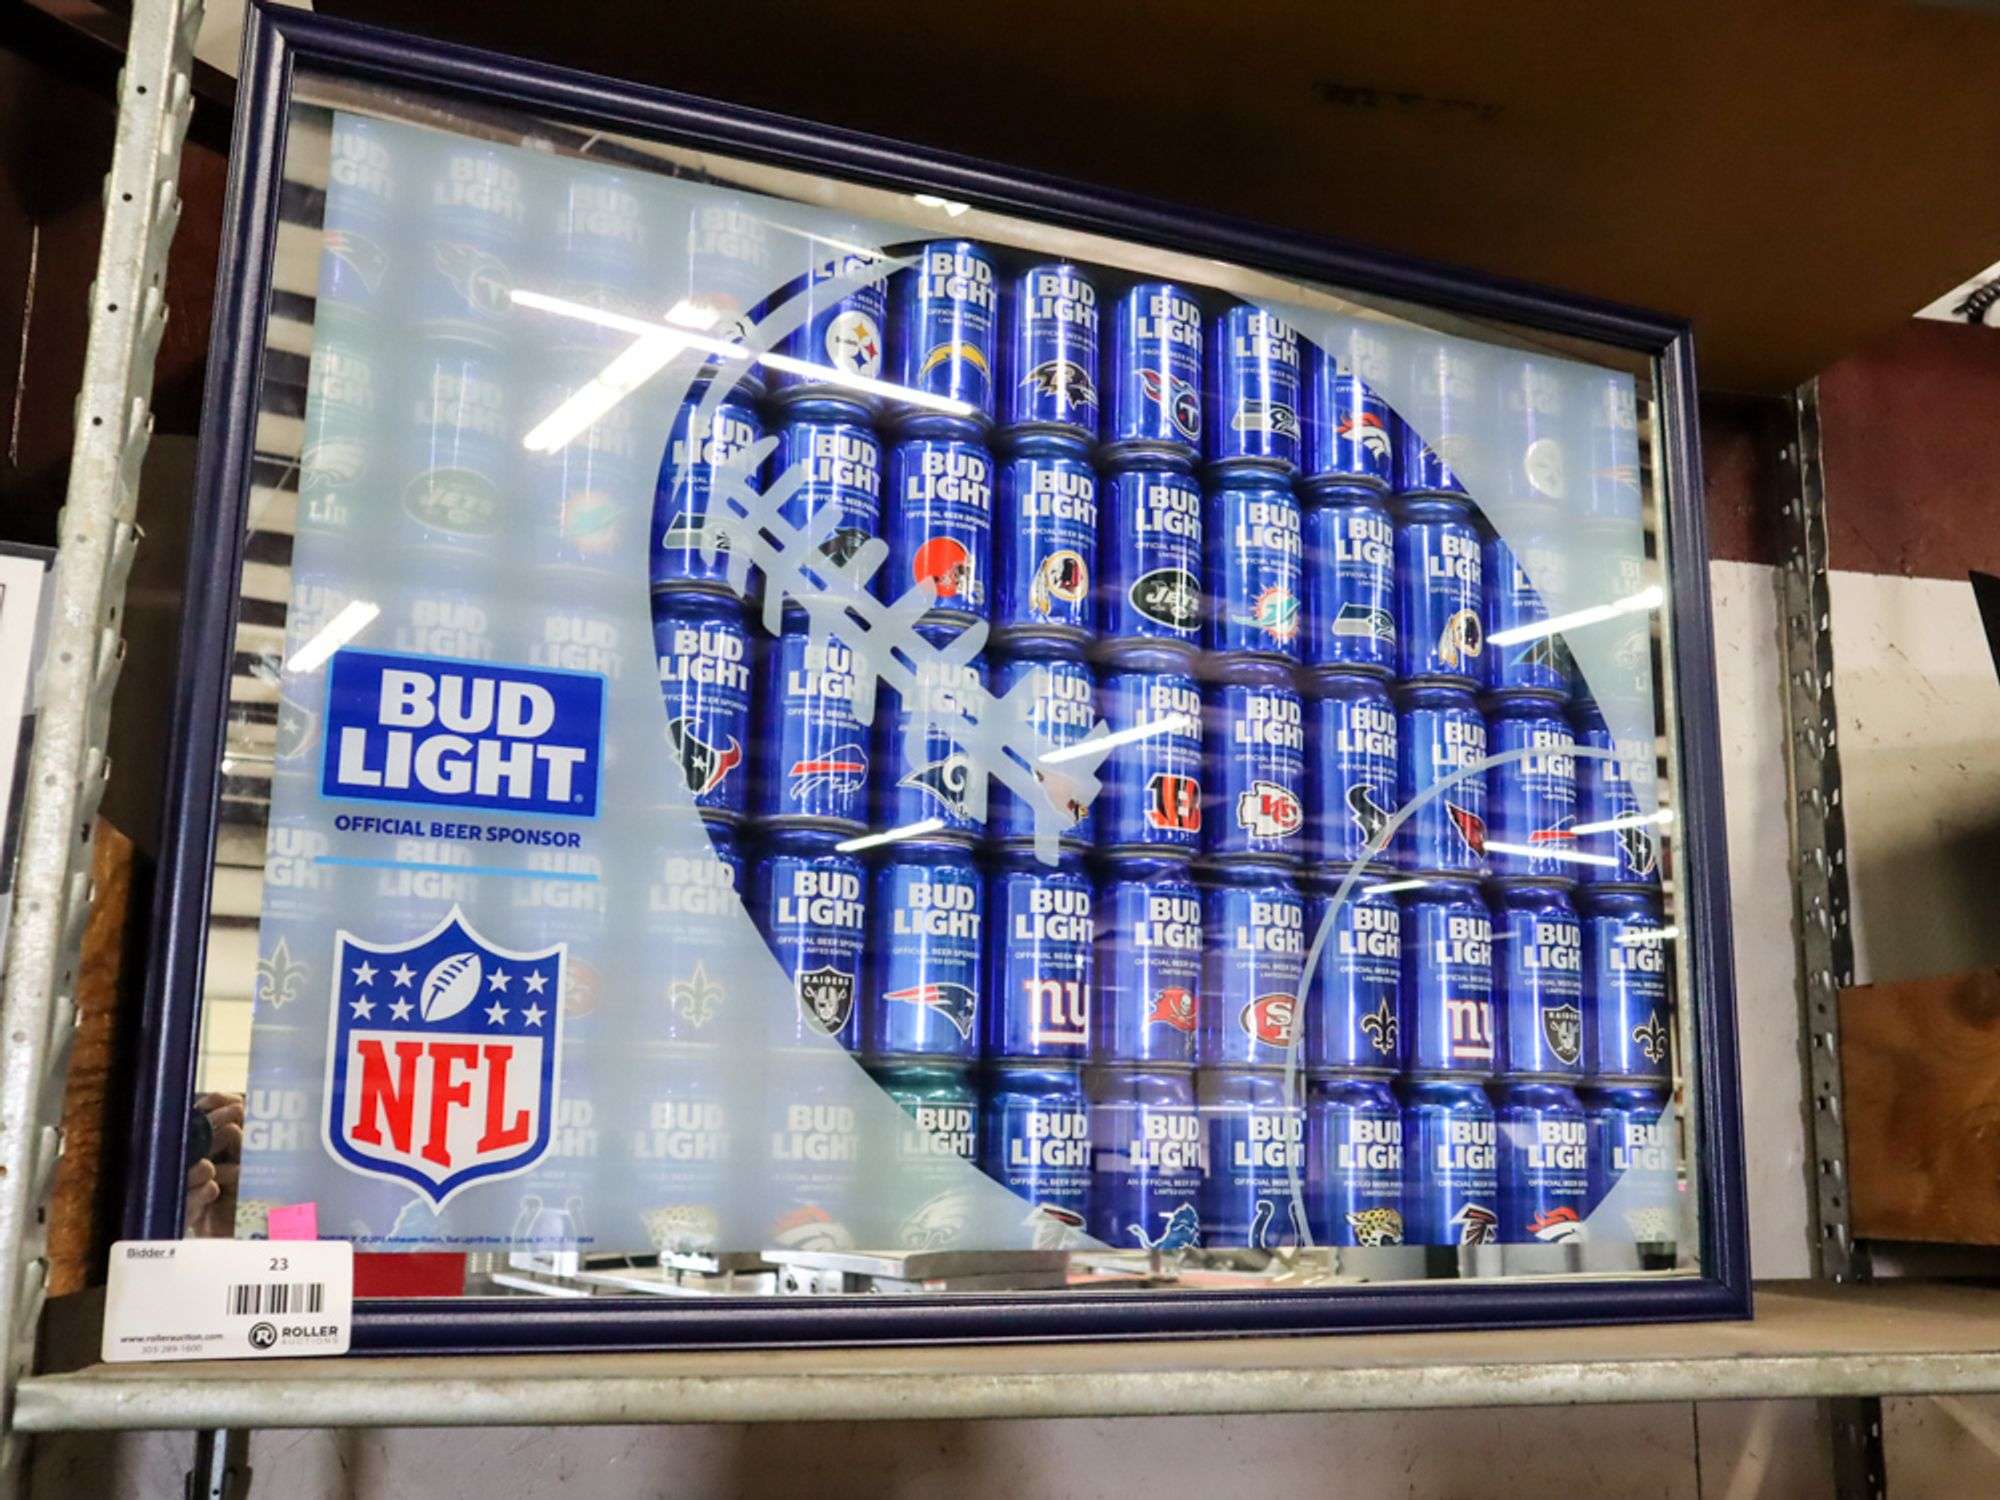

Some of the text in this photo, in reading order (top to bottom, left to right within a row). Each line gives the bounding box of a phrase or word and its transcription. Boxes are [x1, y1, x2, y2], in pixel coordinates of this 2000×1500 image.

[931, 253, 992, 286] BUD
[918, 276, 997, 312] LIGHT
[1038, 275, 1095, 305] BUD
[1151, 295, 1200, 327] BUD
[1249, 314, 1297, 345] BUD
[816, 434, 877, 468] BUD
[802, 457, 881, 498] LIGHT
[922, 452, 985, 482] BUD
[907, 476, 992, 511] LIGHT
[1035, 470, 1093, 501] BUD
[1022, 493, 1098, 528] LIGHT
[1149, 486, 1200, 517] BUD
[1249, 502, 1300, 531] BUD
[1349, 517, 1393, 545] BUD
[546, 616, 619, 650] BUD
[674, 630, 743, 662] BUD
[660, 656, 749, 691] LIGHT
[379, 668, 555, 738] BUD
[1034, 698, 1095, 731] IGHT
[1150, 686, 1200, 713] BUD
[1246, 696, 1300, 726] BUD
[1351, 707, 1398, 734] BUD
[338, 726, 586, 803] LIGHT
[335, 815, 581, 848] OFFICIAL BEER SPONSOR
[664, 857, 735, 886] BUD
[794, 870, 860, 900] BUD
[649, 886, 742, 917] LIGHT
[908, 882, 974, 911] BUD
[1030, 889, 1090, 915] BUD
[1150, 897, 1200, 925] BUD
[778, 897, 865, 930] LIGHT
[894, 909, 980, 939] LIGHT
[1016, 914, 1094, 943] LIGHT
[1251, 902, 1302, 927] BUD
[1354, 908, 1400, 933] BUD
[1535, 923, 1580, 947] BUD
[803, 975, 849, 986] RAIDERS
[245, 1089, 307, 1120] UD
[351, 1040, 529, 1168] NFL
[651, 1101, 724, 1131] BUD
[788, 1104, 854, 1132] BUD
[916, 1107, 972, 1132] BUD
[1026, 1112, 1088, 1139] BUD
[1146, 1115, 1200, 1140] BUD
[1250, 1115, 1303, 1142] BUD
[1353, 1119, 1401, 1143] BUD
[634, 1130, 730, 1160] LIGHT
[772, 1132, 858, 1161] LIGHT
[904, 1131, 975, 1156] LIGHT
[1012, 1138, 1092, 1166] LIGHT
[1130, 1141, 1201, 1166] LIGH
[126, 1247, 165, 1259] Bidder
[269, 1258, 289, 1271] 23
[282, 1326, 338, 1337] ROLLER
